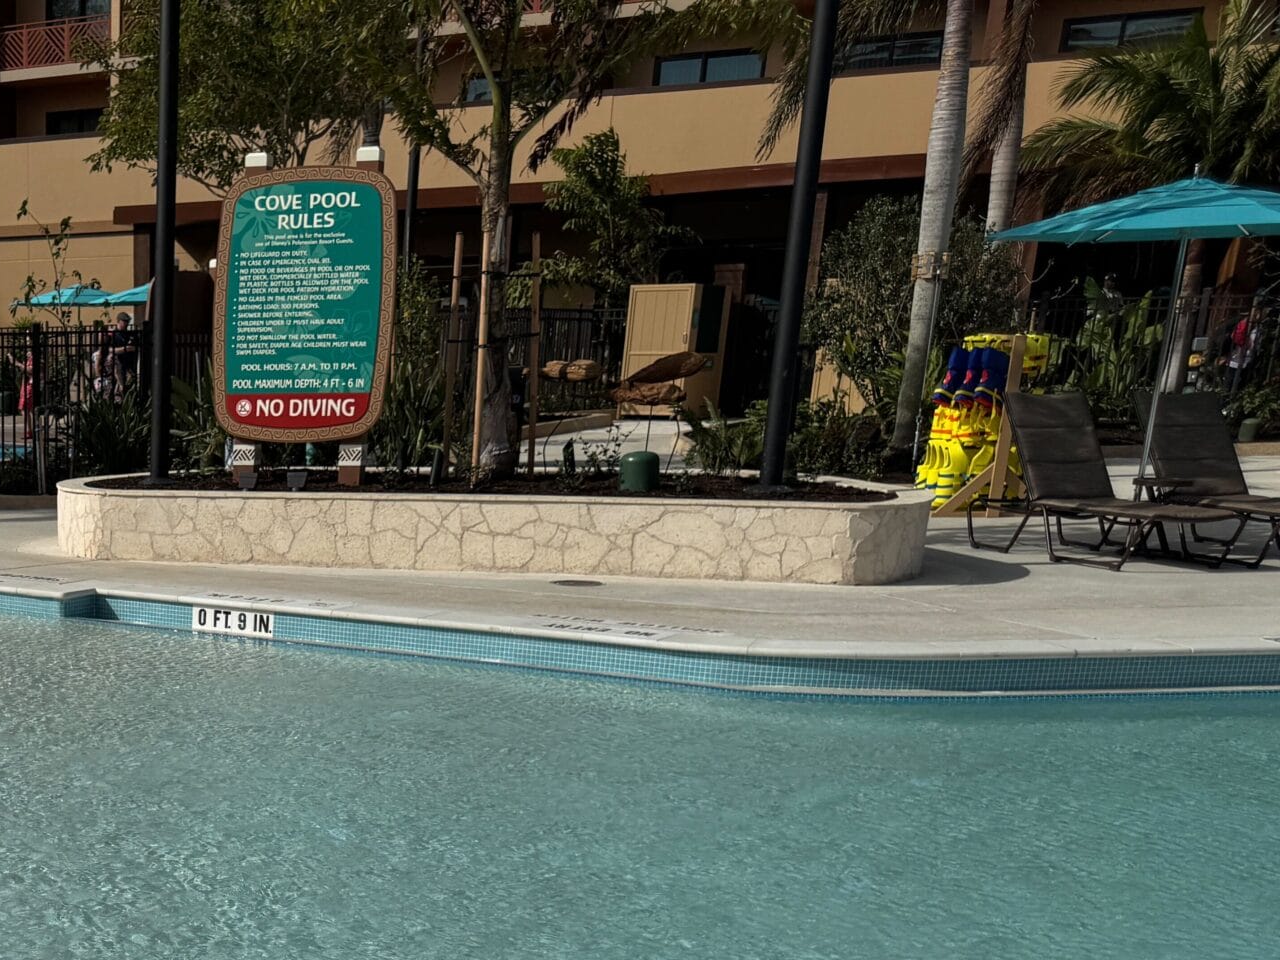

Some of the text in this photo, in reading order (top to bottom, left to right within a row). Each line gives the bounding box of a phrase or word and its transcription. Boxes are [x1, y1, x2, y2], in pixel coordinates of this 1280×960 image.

[254, 192, 361, 211] COVE POOL
[278, 212, 335, 230] RULES
[232, 379, 253, 389] POOL
[254, 379, 292, 388] MAXIMUM
[294, 378, 321, 388] DEPTH:
[323, 378, 328, 388] 4
[330, 378, 340, 388] FT
[348, 378, 354, 388] 6
[355, 378, 365, 388] IN
[256, 398, 355, 417] NO DIVING
[214, 610, 231, 629] FT.
[238, 613, 247, 630] 9
[253, 614, 272, 633] IN.
